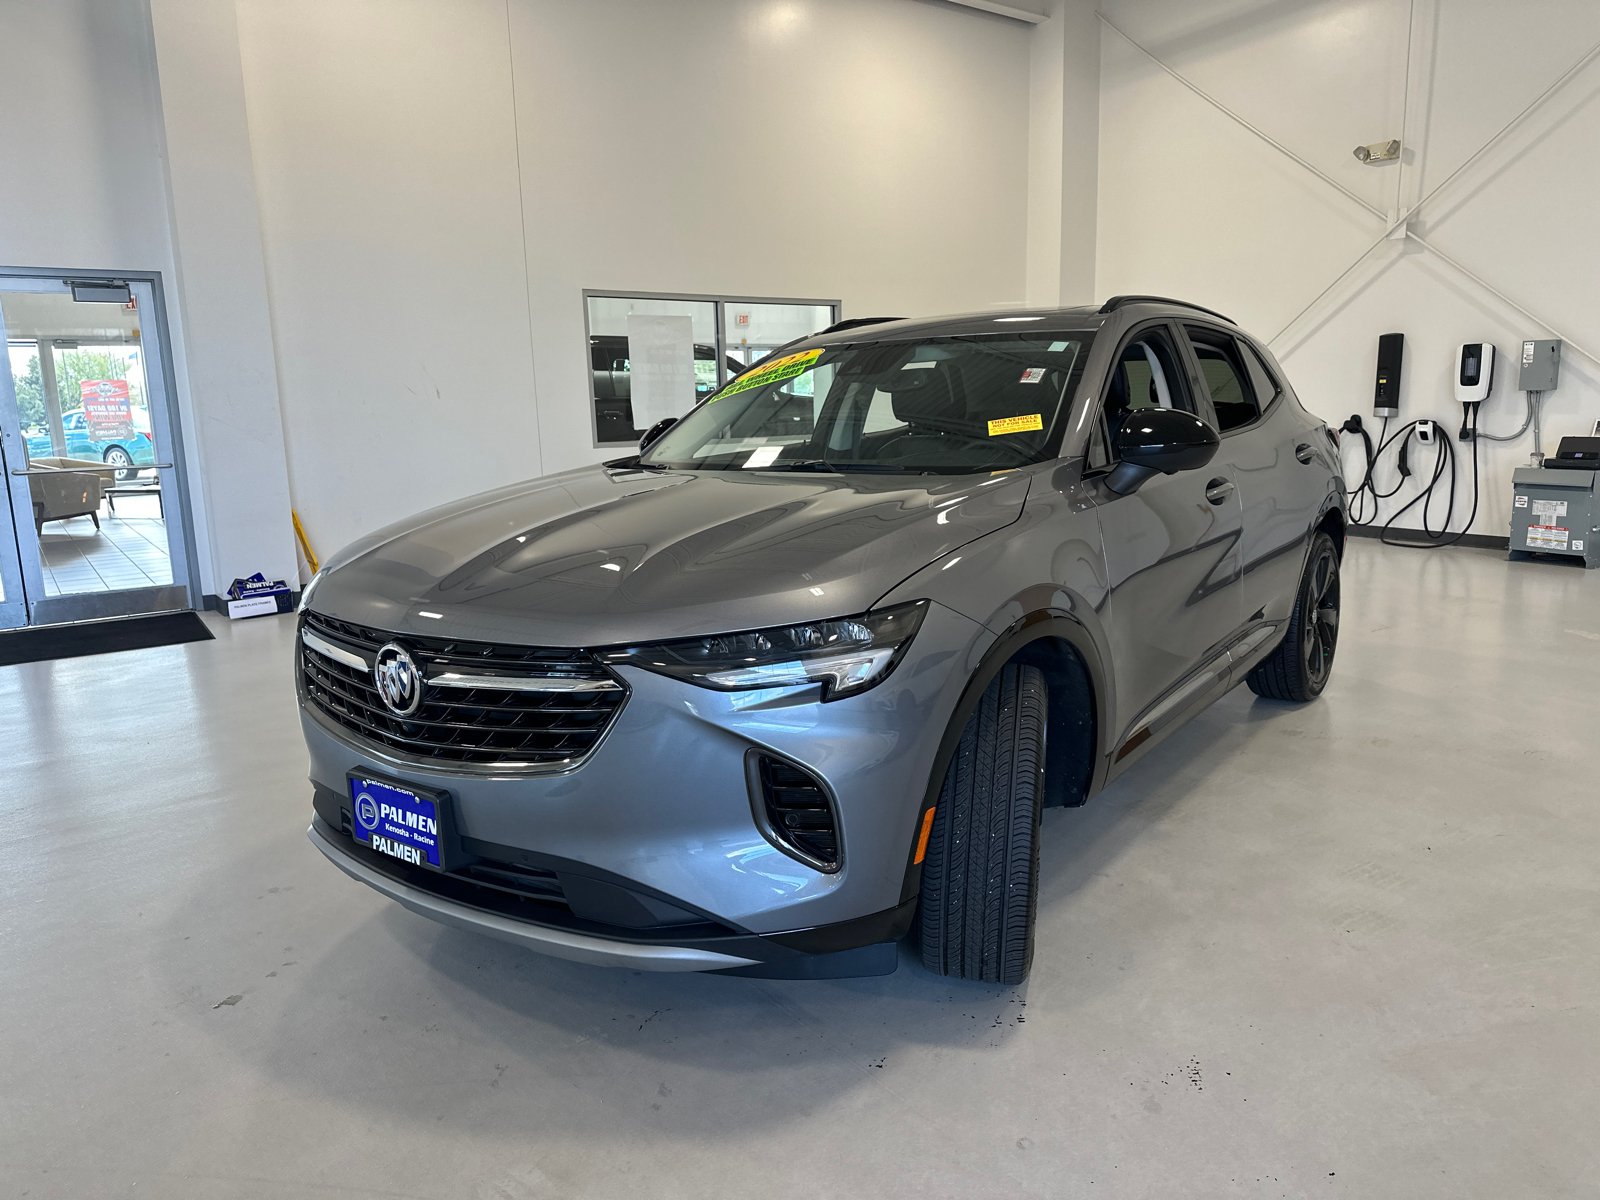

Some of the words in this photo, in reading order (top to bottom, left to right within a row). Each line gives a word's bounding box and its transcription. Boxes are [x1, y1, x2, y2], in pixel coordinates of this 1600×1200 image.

[781, 357, 816, 371] DRIVE
[735, 375, 773, 392] BUTTON
[771, 366, 805, 381] START
[365, 779, 414, 797] palmen.com
[380, 803, 437, 835] PALMEN
[385, 823, 409, 838] Kenosha
[413, 832, 435, 846] Racine
[372, 834, 421, 866] PALMEN
